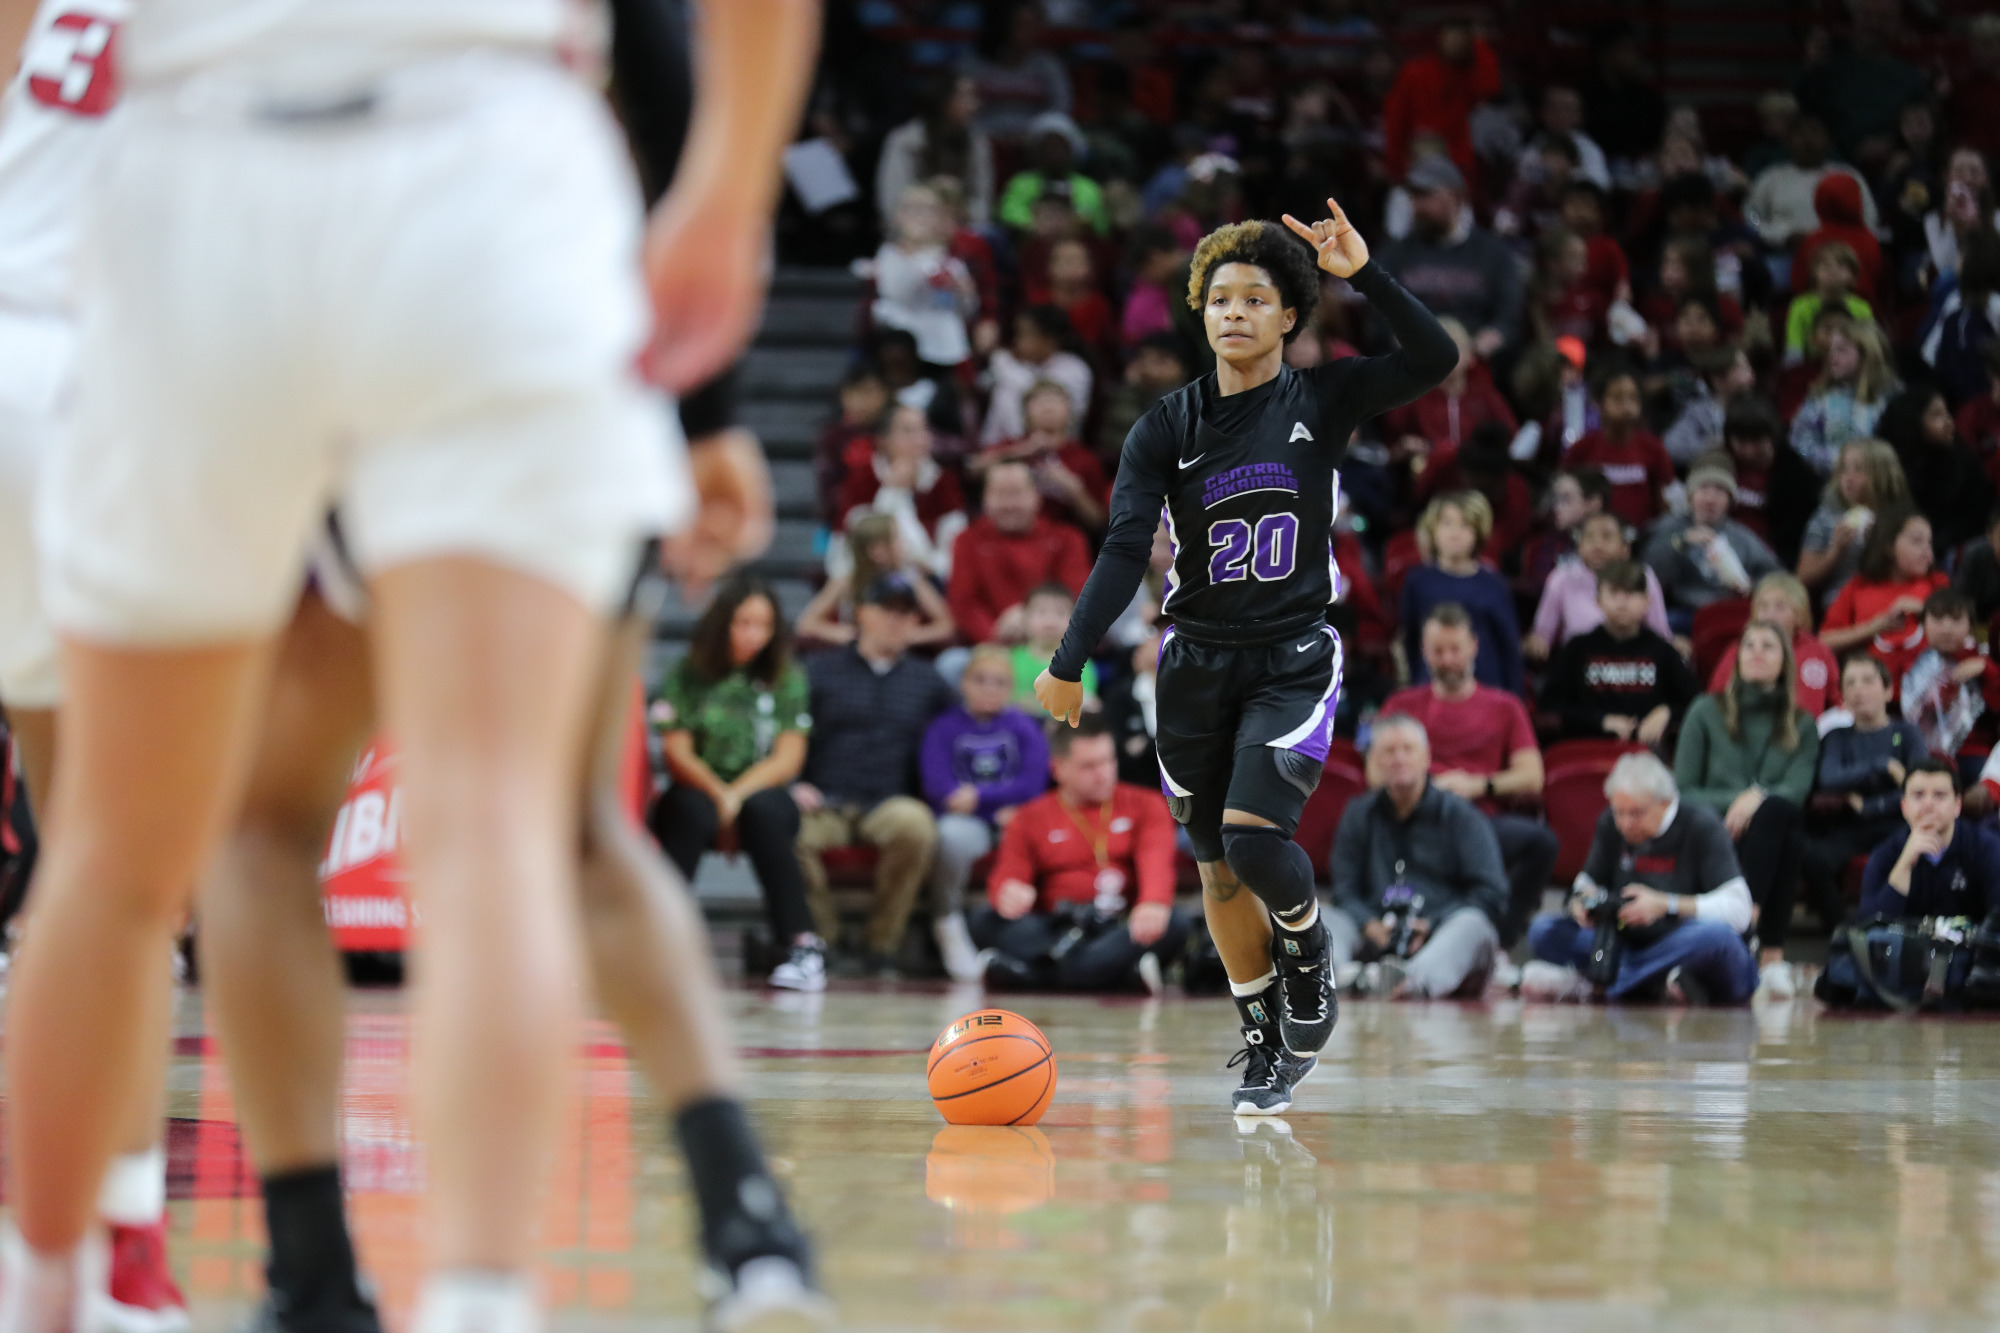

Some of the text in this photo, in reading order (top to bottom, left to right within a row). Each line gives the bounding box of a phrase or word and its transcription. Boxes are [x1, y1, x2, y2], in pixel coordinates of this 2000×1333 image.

[1201, 475, 1299, 507] ARKANSAS
[1204, 462, 1293, 492] CENTRAL
[1207, 511, 1300, 586] 20
